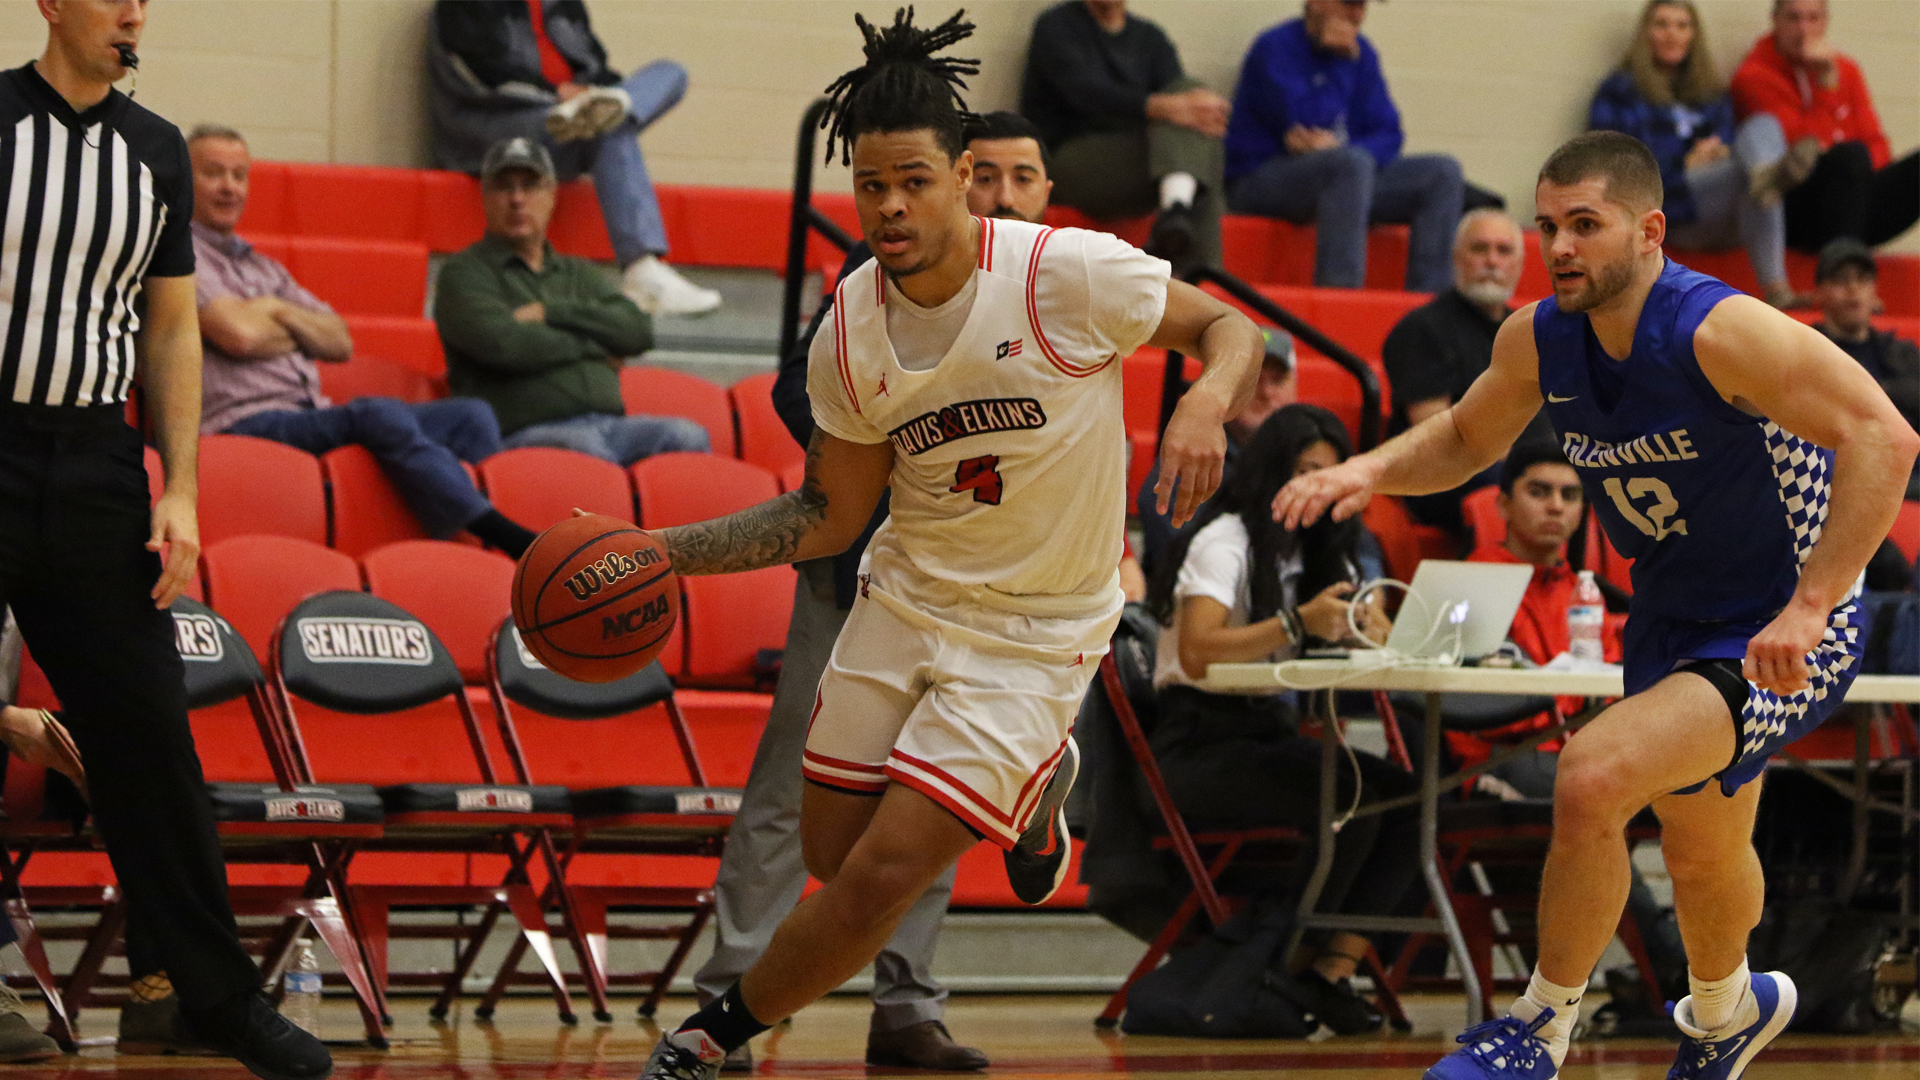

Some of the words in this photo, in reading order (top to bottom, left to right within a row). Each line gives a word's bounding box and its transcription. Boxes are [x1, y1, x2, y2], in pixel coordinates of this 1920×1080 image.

[1563, 429, 1699, 468] GLENVILLE
[949, 454, 1003, 505] 4
[1602, 477, 1688, 541] 12
[563, 546, 663, 601] Wilson
[602, 593, 670, 639] NCAA
[303, 623, 427, 659] SENATORS
